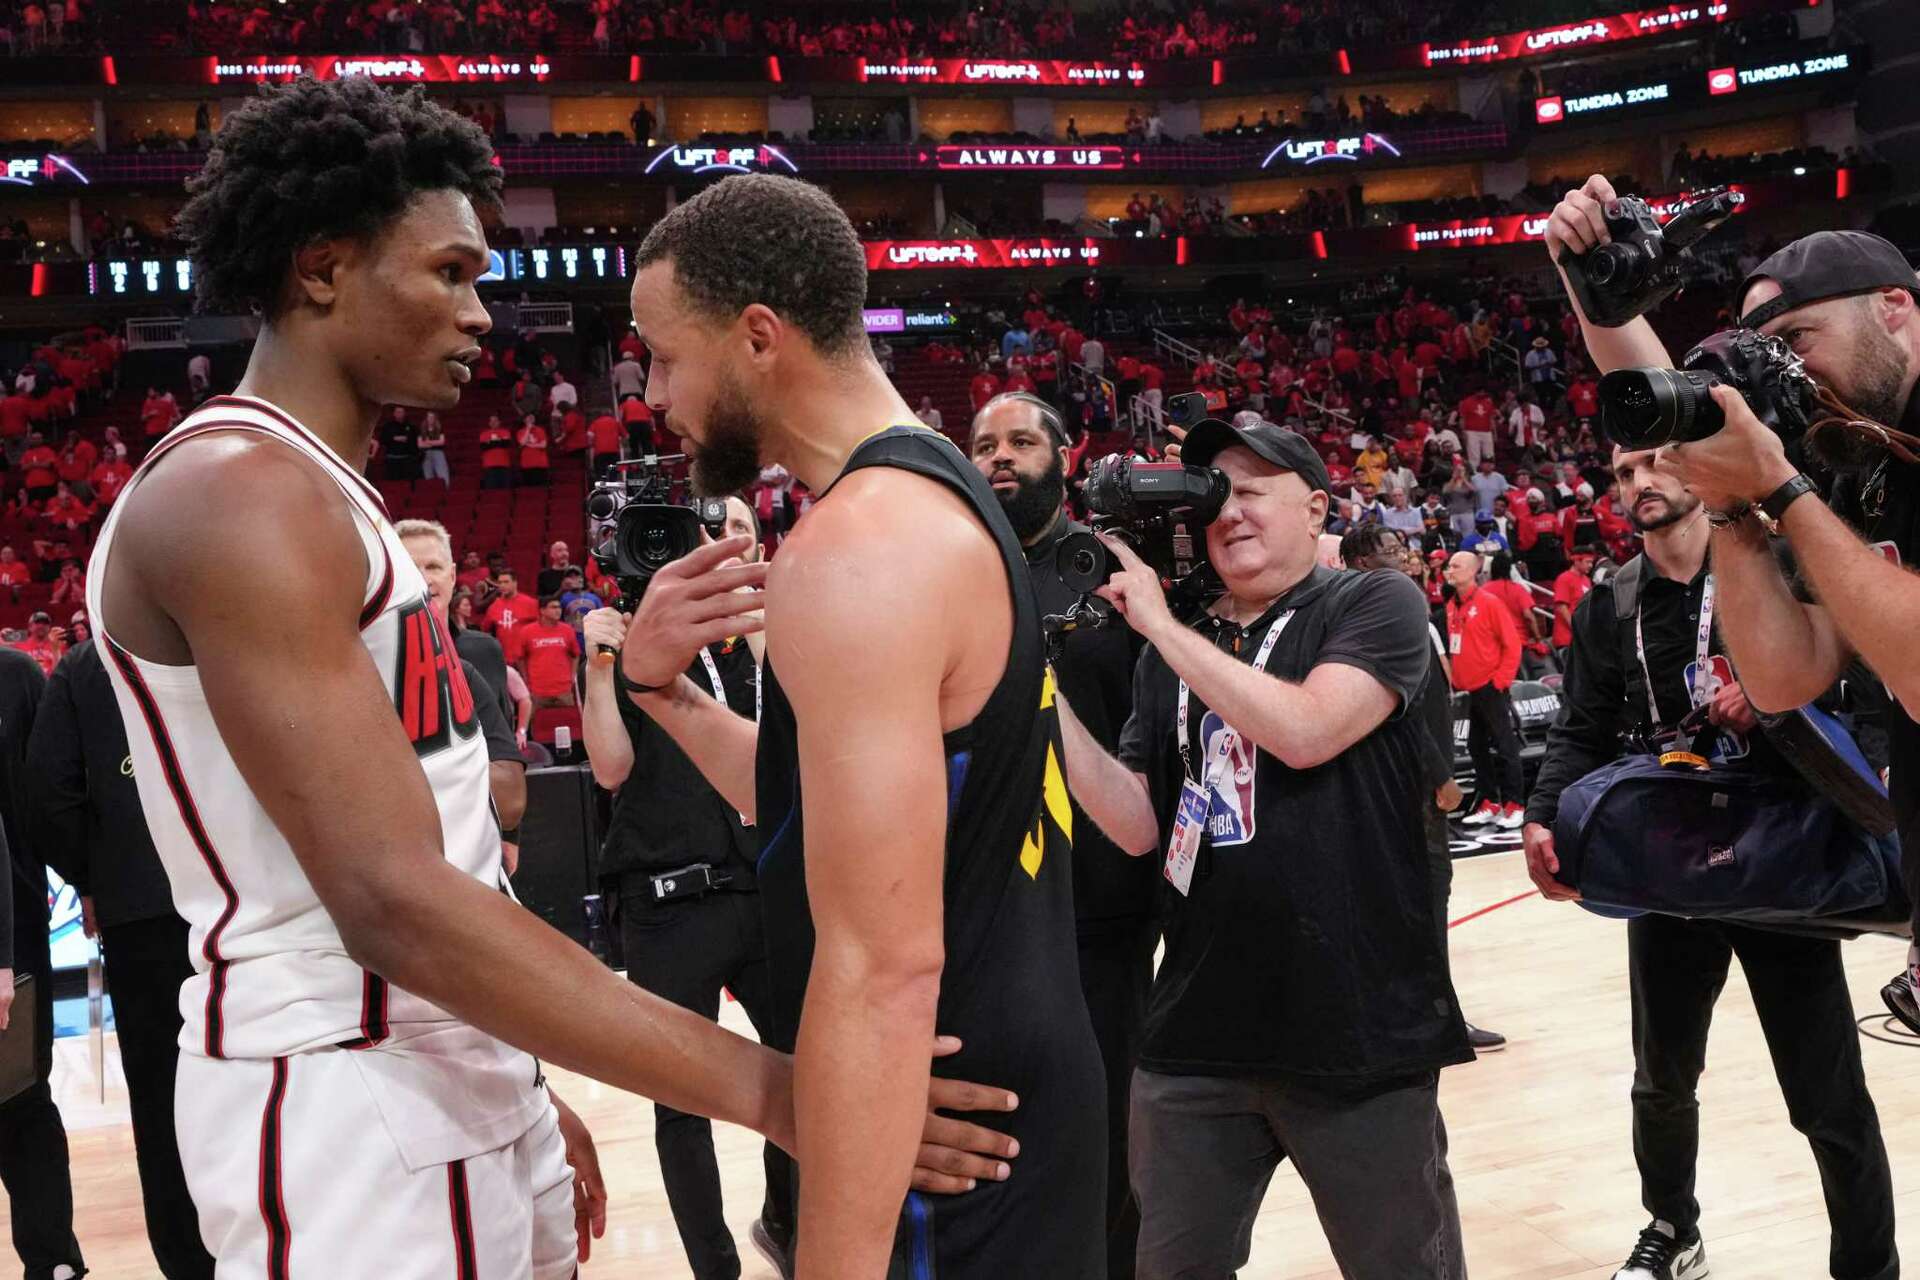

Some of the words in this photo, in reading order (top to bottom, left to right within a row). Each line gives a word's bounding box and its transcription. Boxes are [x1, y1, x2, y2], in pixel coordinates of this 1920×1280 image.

[1427, 49, 1451, 60] 2025
[1453, 44, 1499, 58] PLAYOFFS
[1640, 8, 1699, 28] ALWAYS
[1708, 4, 1727, 16] US
[215, 64, 243, 75] 2025
[246, 64, 302, 75] PLAYOFFS
[458, 64, 520, 75] ALWAYS
[529, 64, 549, 75] US
[864, 65, 888, 75] 2025
[890, 65, 938, 75] PLAYOFFS
[1068, 68, 1120, 79] ALWAYS
[1127, 69, 1144, 80] US
[1739, 62, 1800, 84] TUNDRA
[1804, 54, 1848, 74] ZONE
[1564, 92, 1623, 113] TUNDRA
[1626, 84, 1668, 103] ZONE
[673, 148, 755, 166] LIFTOFF
[1286, 138, 1360, 159] LIFTOFF
[959, 150, 1056, 165] ALWAYS
[1072, 150, 1102, 165] US
[1414, 230, 1439, 242] 2025
[1442, 226, 1494, 240] PLAYOFFS
[1011, 248, 1071, 259] ALWAYS
[1080, 247, 1099, 258] US
[906, 312, 944, 326] reliant
[1209, 813, 1236, 837] NBA
